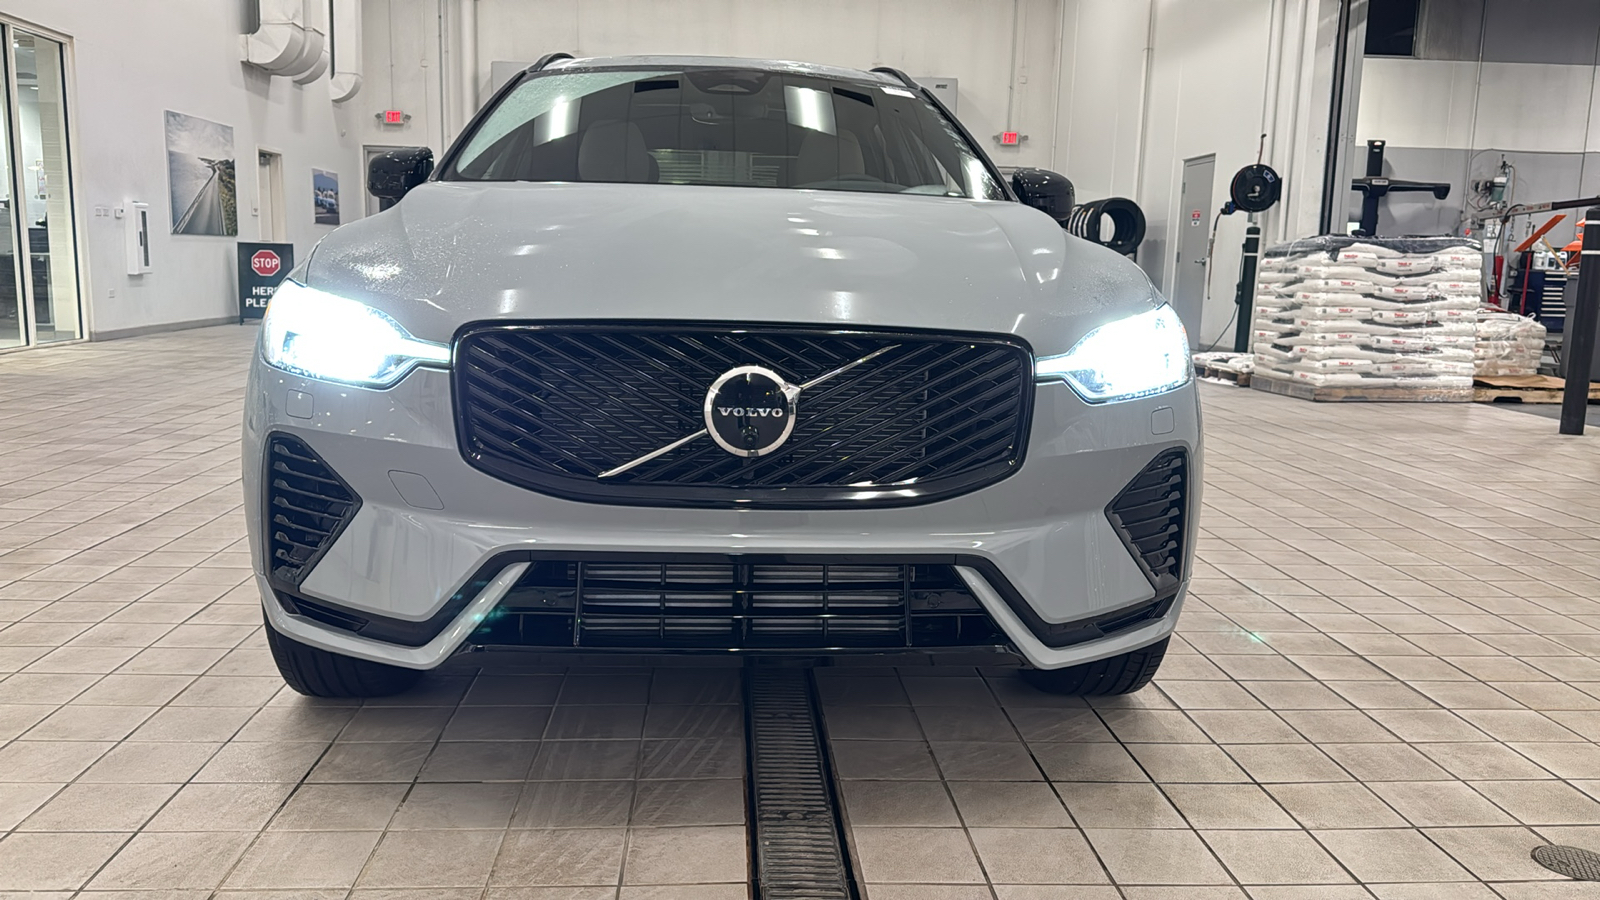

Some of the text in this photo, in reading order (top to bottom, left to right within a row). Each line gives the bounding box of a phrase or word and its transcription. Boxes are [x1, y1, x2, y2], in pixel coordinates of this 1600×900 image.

[253, 258, 279, 269] STOP
[245, 298, 271, 308] PLE
[717, 407, 783, 418] VOLVO
